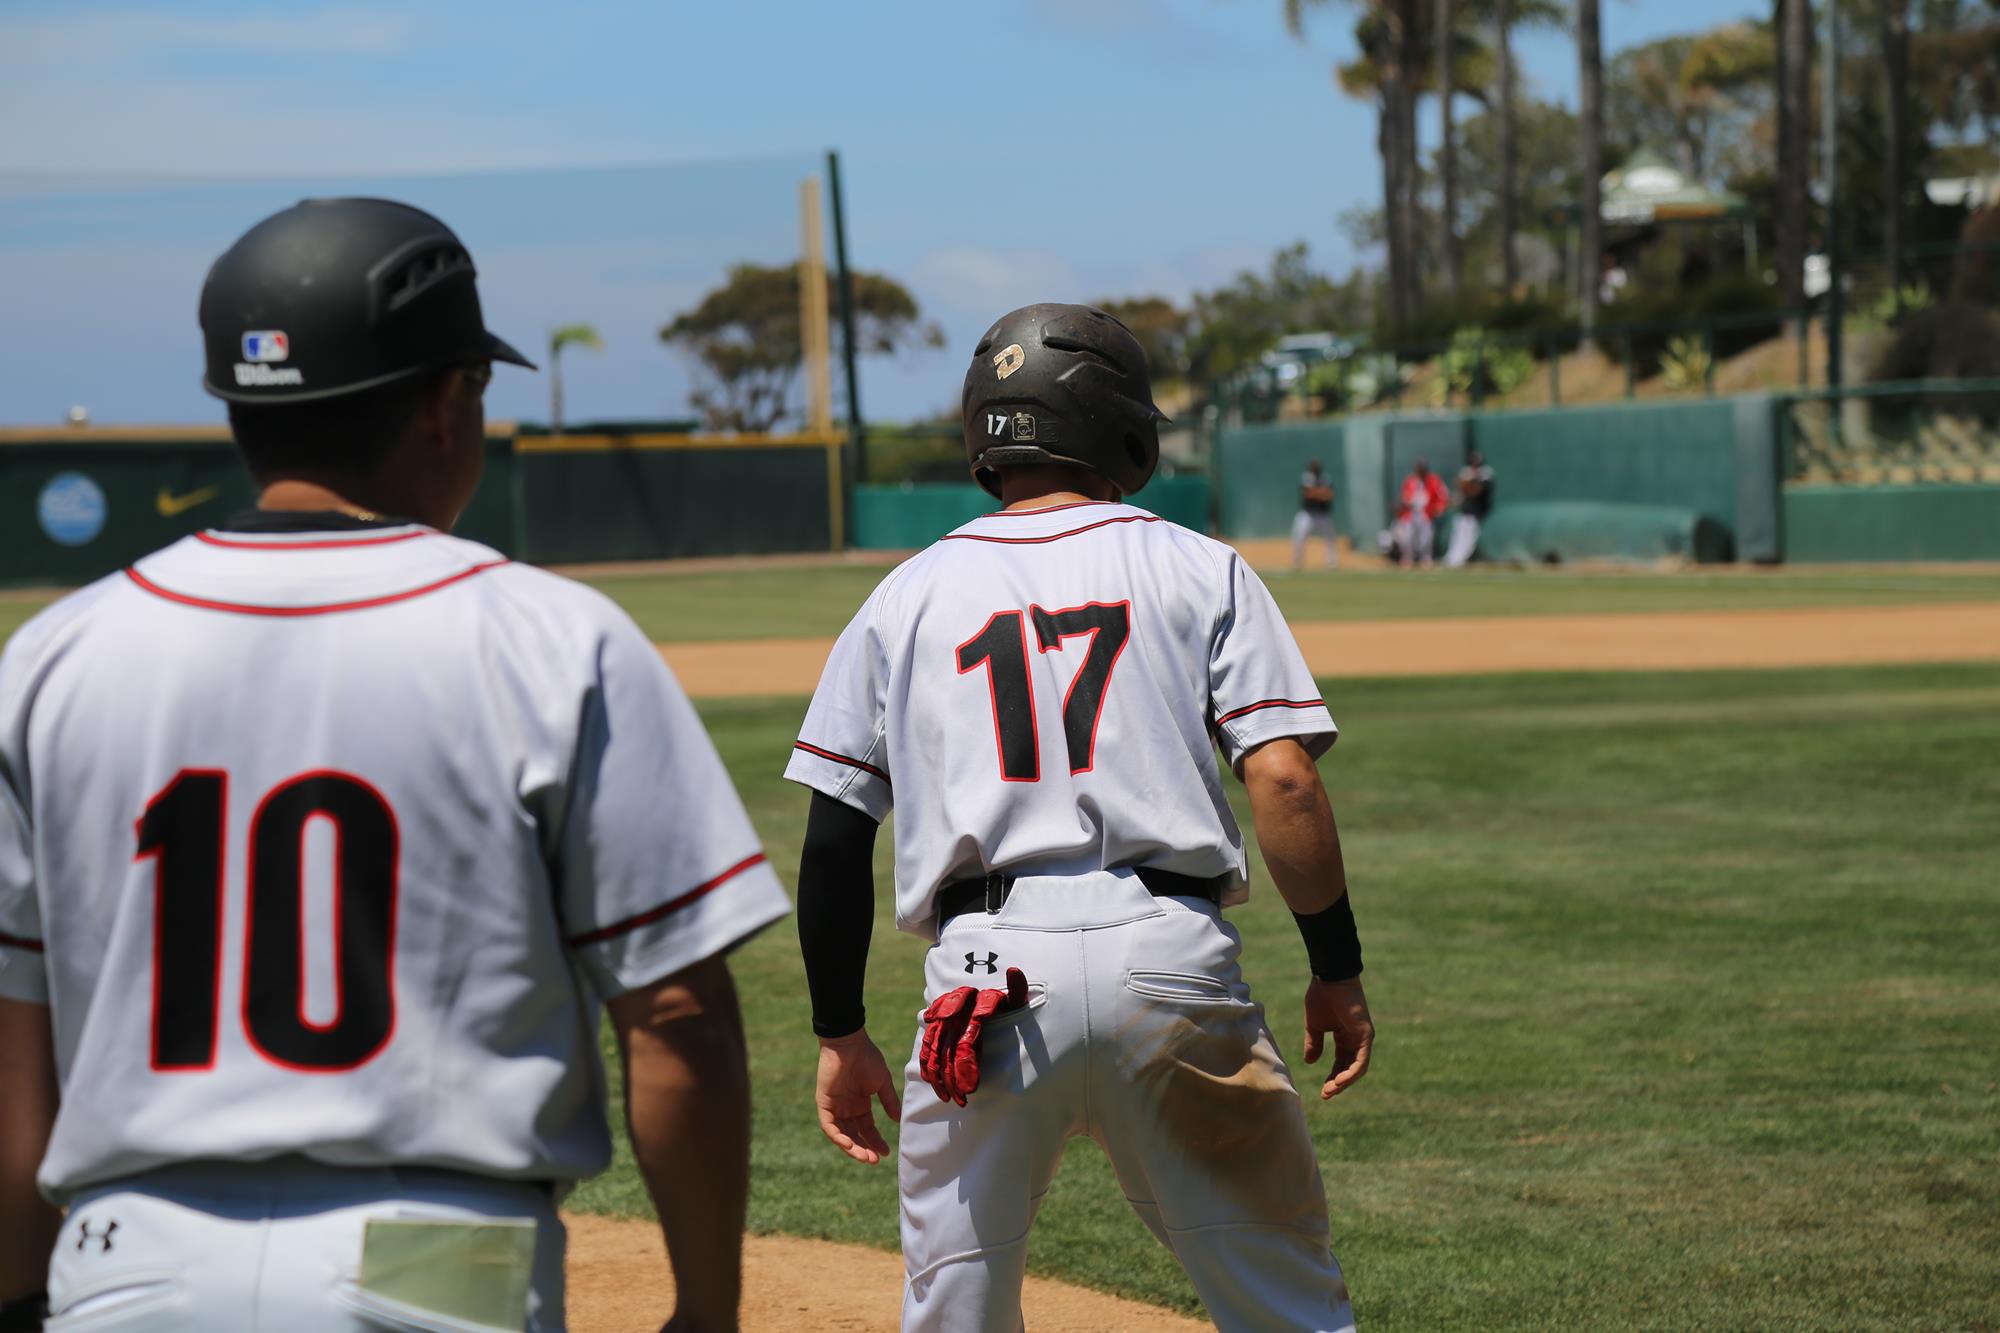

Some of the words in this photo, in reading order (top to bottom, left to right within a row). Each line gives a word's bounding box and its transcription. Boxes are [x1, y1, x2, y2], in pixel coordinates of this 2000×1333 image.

[986, 413, 1008, 436] 17
[955, 599, 1131, 782] 17
[132, 767, 402, 1076] 10
